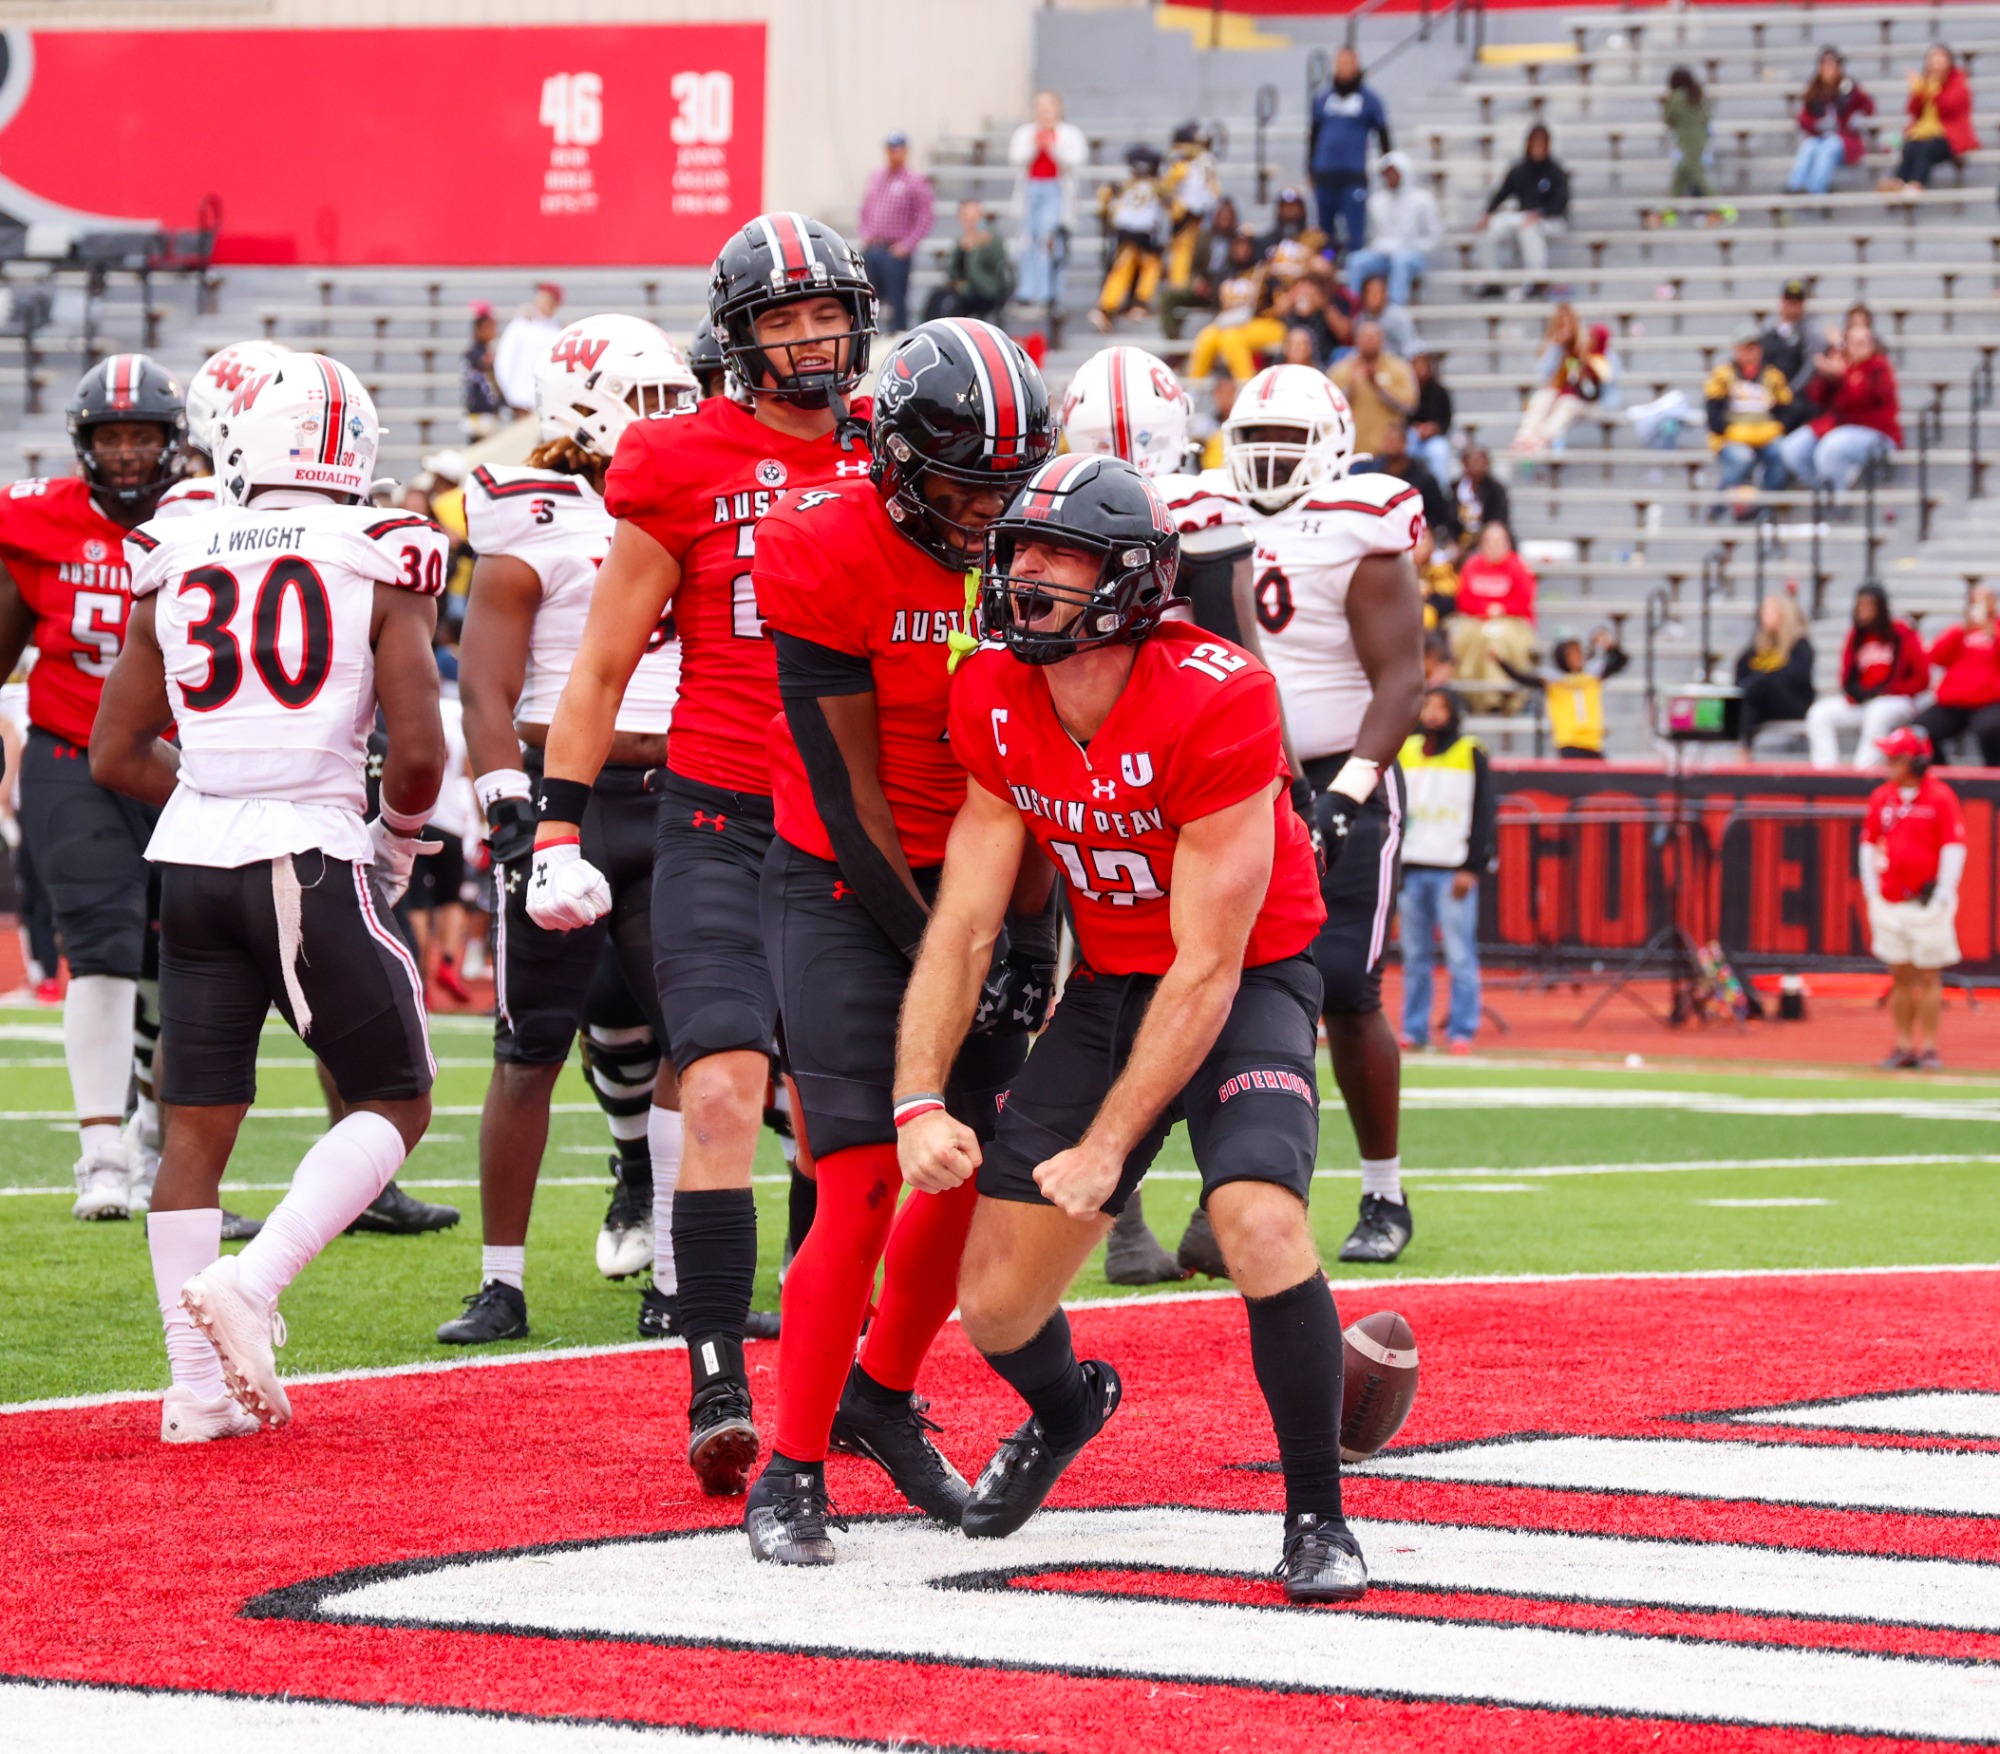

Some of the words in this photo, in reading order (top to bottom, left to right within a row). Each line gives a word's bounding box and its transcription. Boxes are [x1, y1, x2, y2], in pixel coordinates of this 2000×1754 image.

[539, 72, 603, 146] 46
[670, 70, 733, 145] 30
[295, 469, 361, 487] EQUALITY
[341, 451, 356, 467] 30
[207, 532, 220, 556] J.
[229, 527, 306, 552] WRIGHT
[396, 545, 442, 594] 30
[71, 591, 122, 678] 5
[176, 555, 333, 712] 30
[1178, 642, 1249, 684] 12
[991, 708, 1008, 757] C
[1006, 778, 1086, 834] USTIN
[1497, 789, 2000, 962] GOVER
